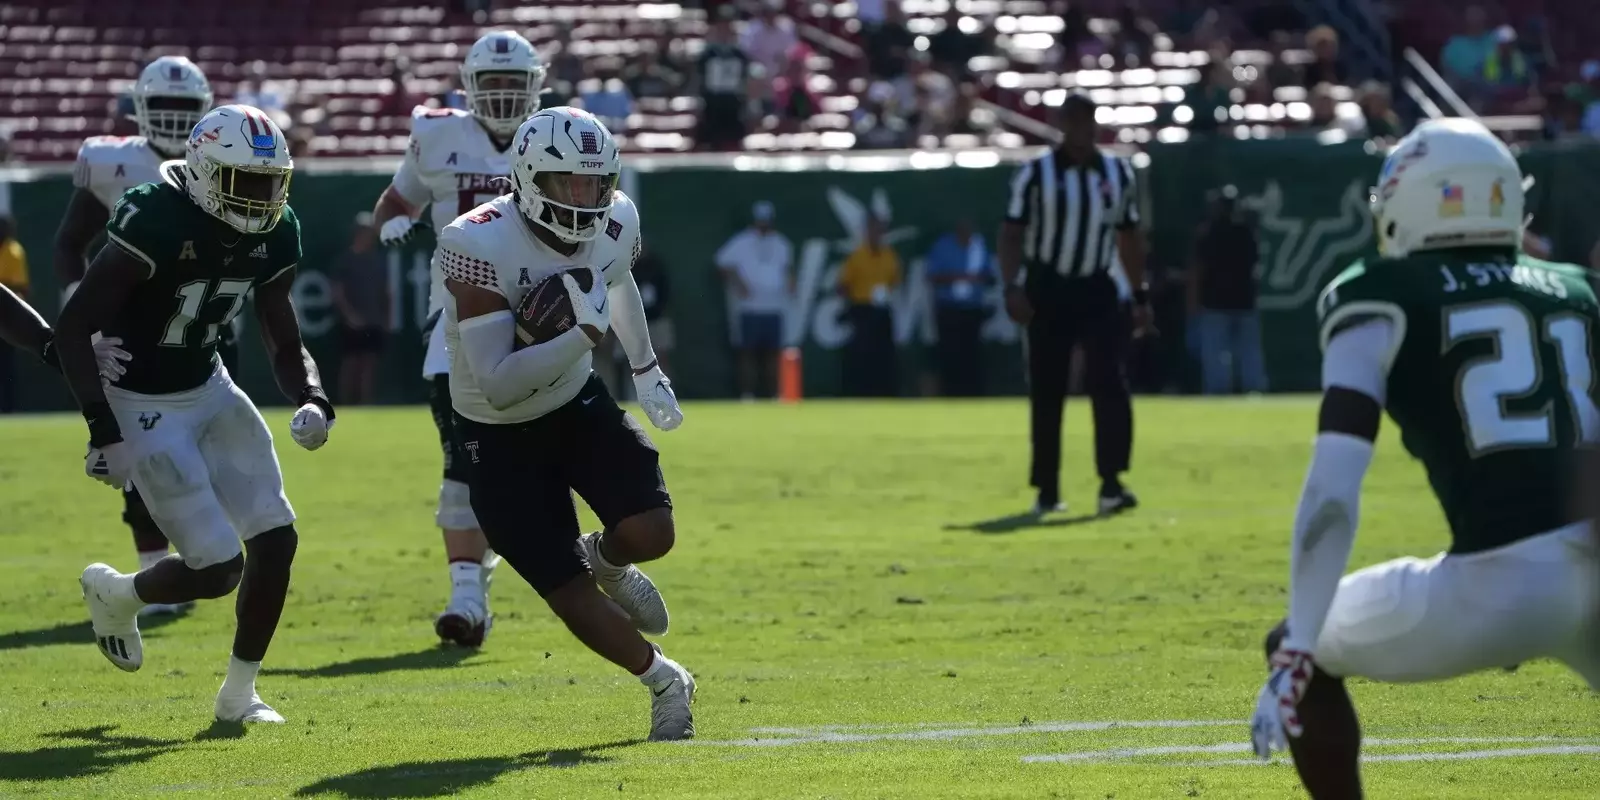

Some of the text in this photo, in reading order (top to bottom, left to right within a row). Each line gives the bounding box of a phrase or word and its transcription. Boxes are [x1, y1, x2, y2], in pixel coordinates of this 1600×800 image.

[517, 126, 538, 157] 5
[580, 160, 604, 169] TUFF
[178, 240, 198, 260] A
[516, 266, 533, 287] A
[157, 277, 256, 348] 17
[1440, 298, 1600, 459] 21
[465, 441, 480, 464] T
